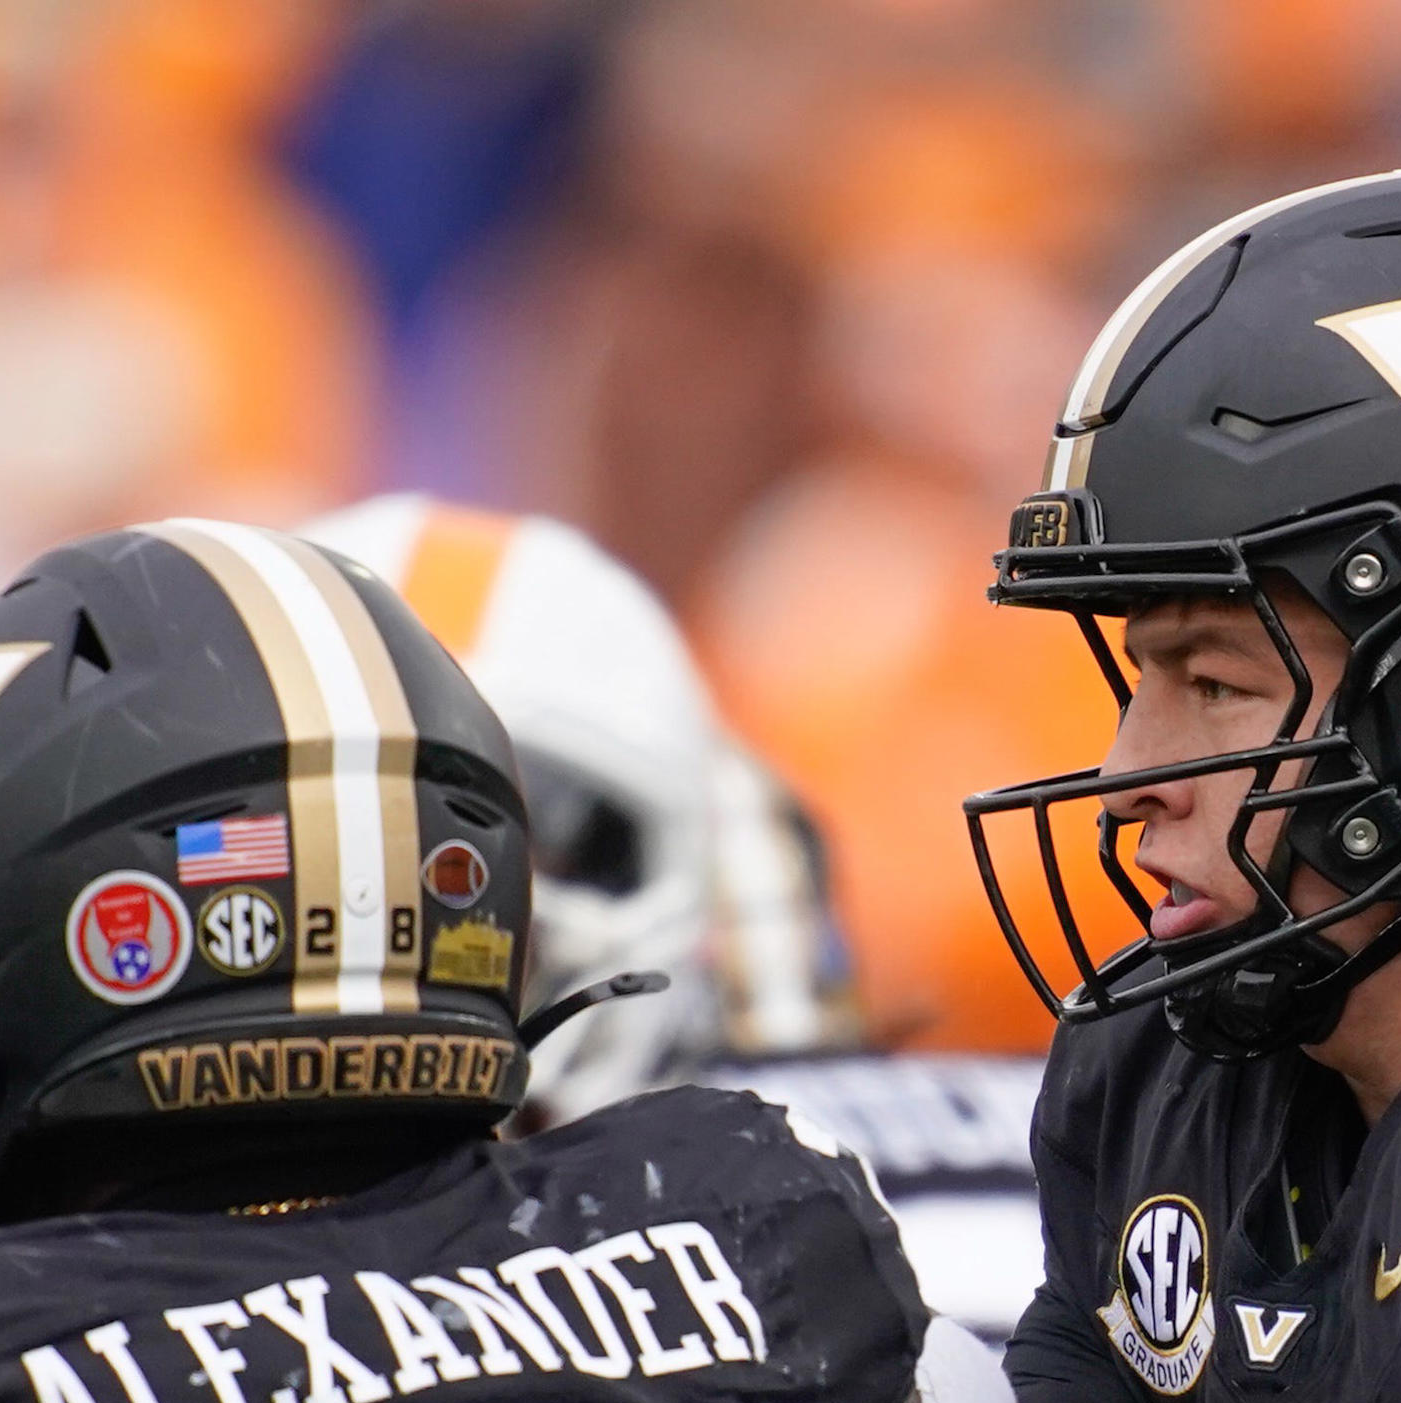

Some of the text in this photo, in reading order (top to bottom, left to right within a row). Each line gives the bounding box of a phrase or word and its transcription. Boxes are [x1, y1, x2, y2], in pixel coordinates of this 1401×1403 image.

[205, 893, 277, 968] SEC
[138, 1034, 515, 1111] VANDERBILT
[1125, 1206, 1202, 1342] SEC
[1122, 1331, 1204, 1390] GRADUATE
[1235, 1304, 1307, 1364] V
